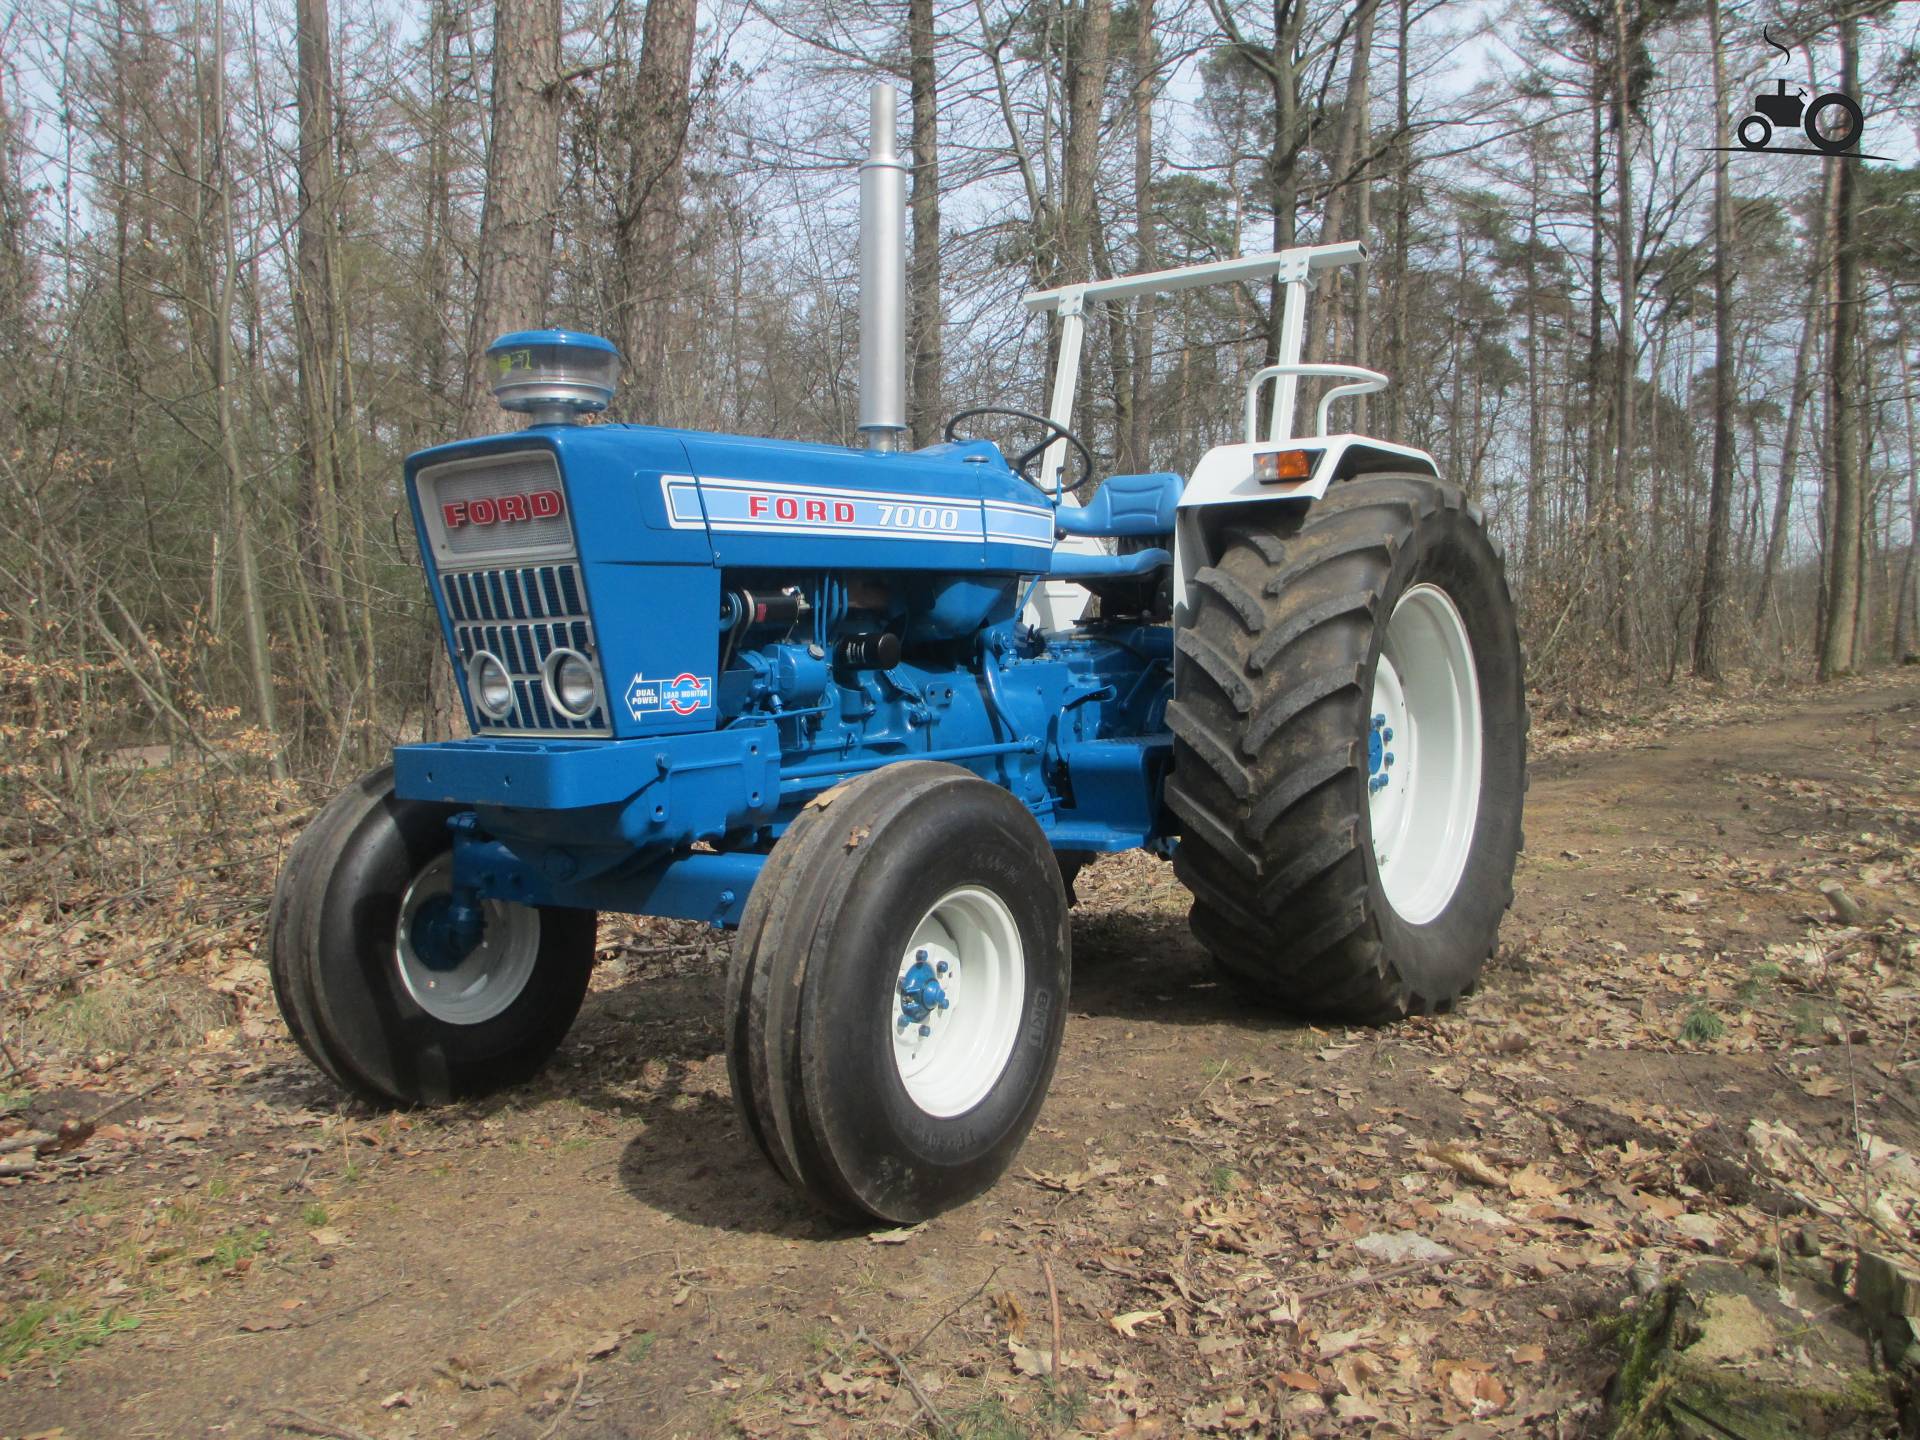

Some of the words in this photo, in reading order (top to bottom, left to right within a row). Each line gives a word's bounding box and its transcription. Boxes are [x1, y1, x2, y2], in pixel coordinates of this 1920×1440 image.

[443, 490, 562, 529] FORD
[748, 496, 855, 523] FORD
[878, 504, 959, 530] 7000
[636, 689, 655, 697] DUAL
[663, 690, 679, 699] LOAD
[681, 689, 708, 698] MONITOR
[632, 696, 658, 705] POWER
